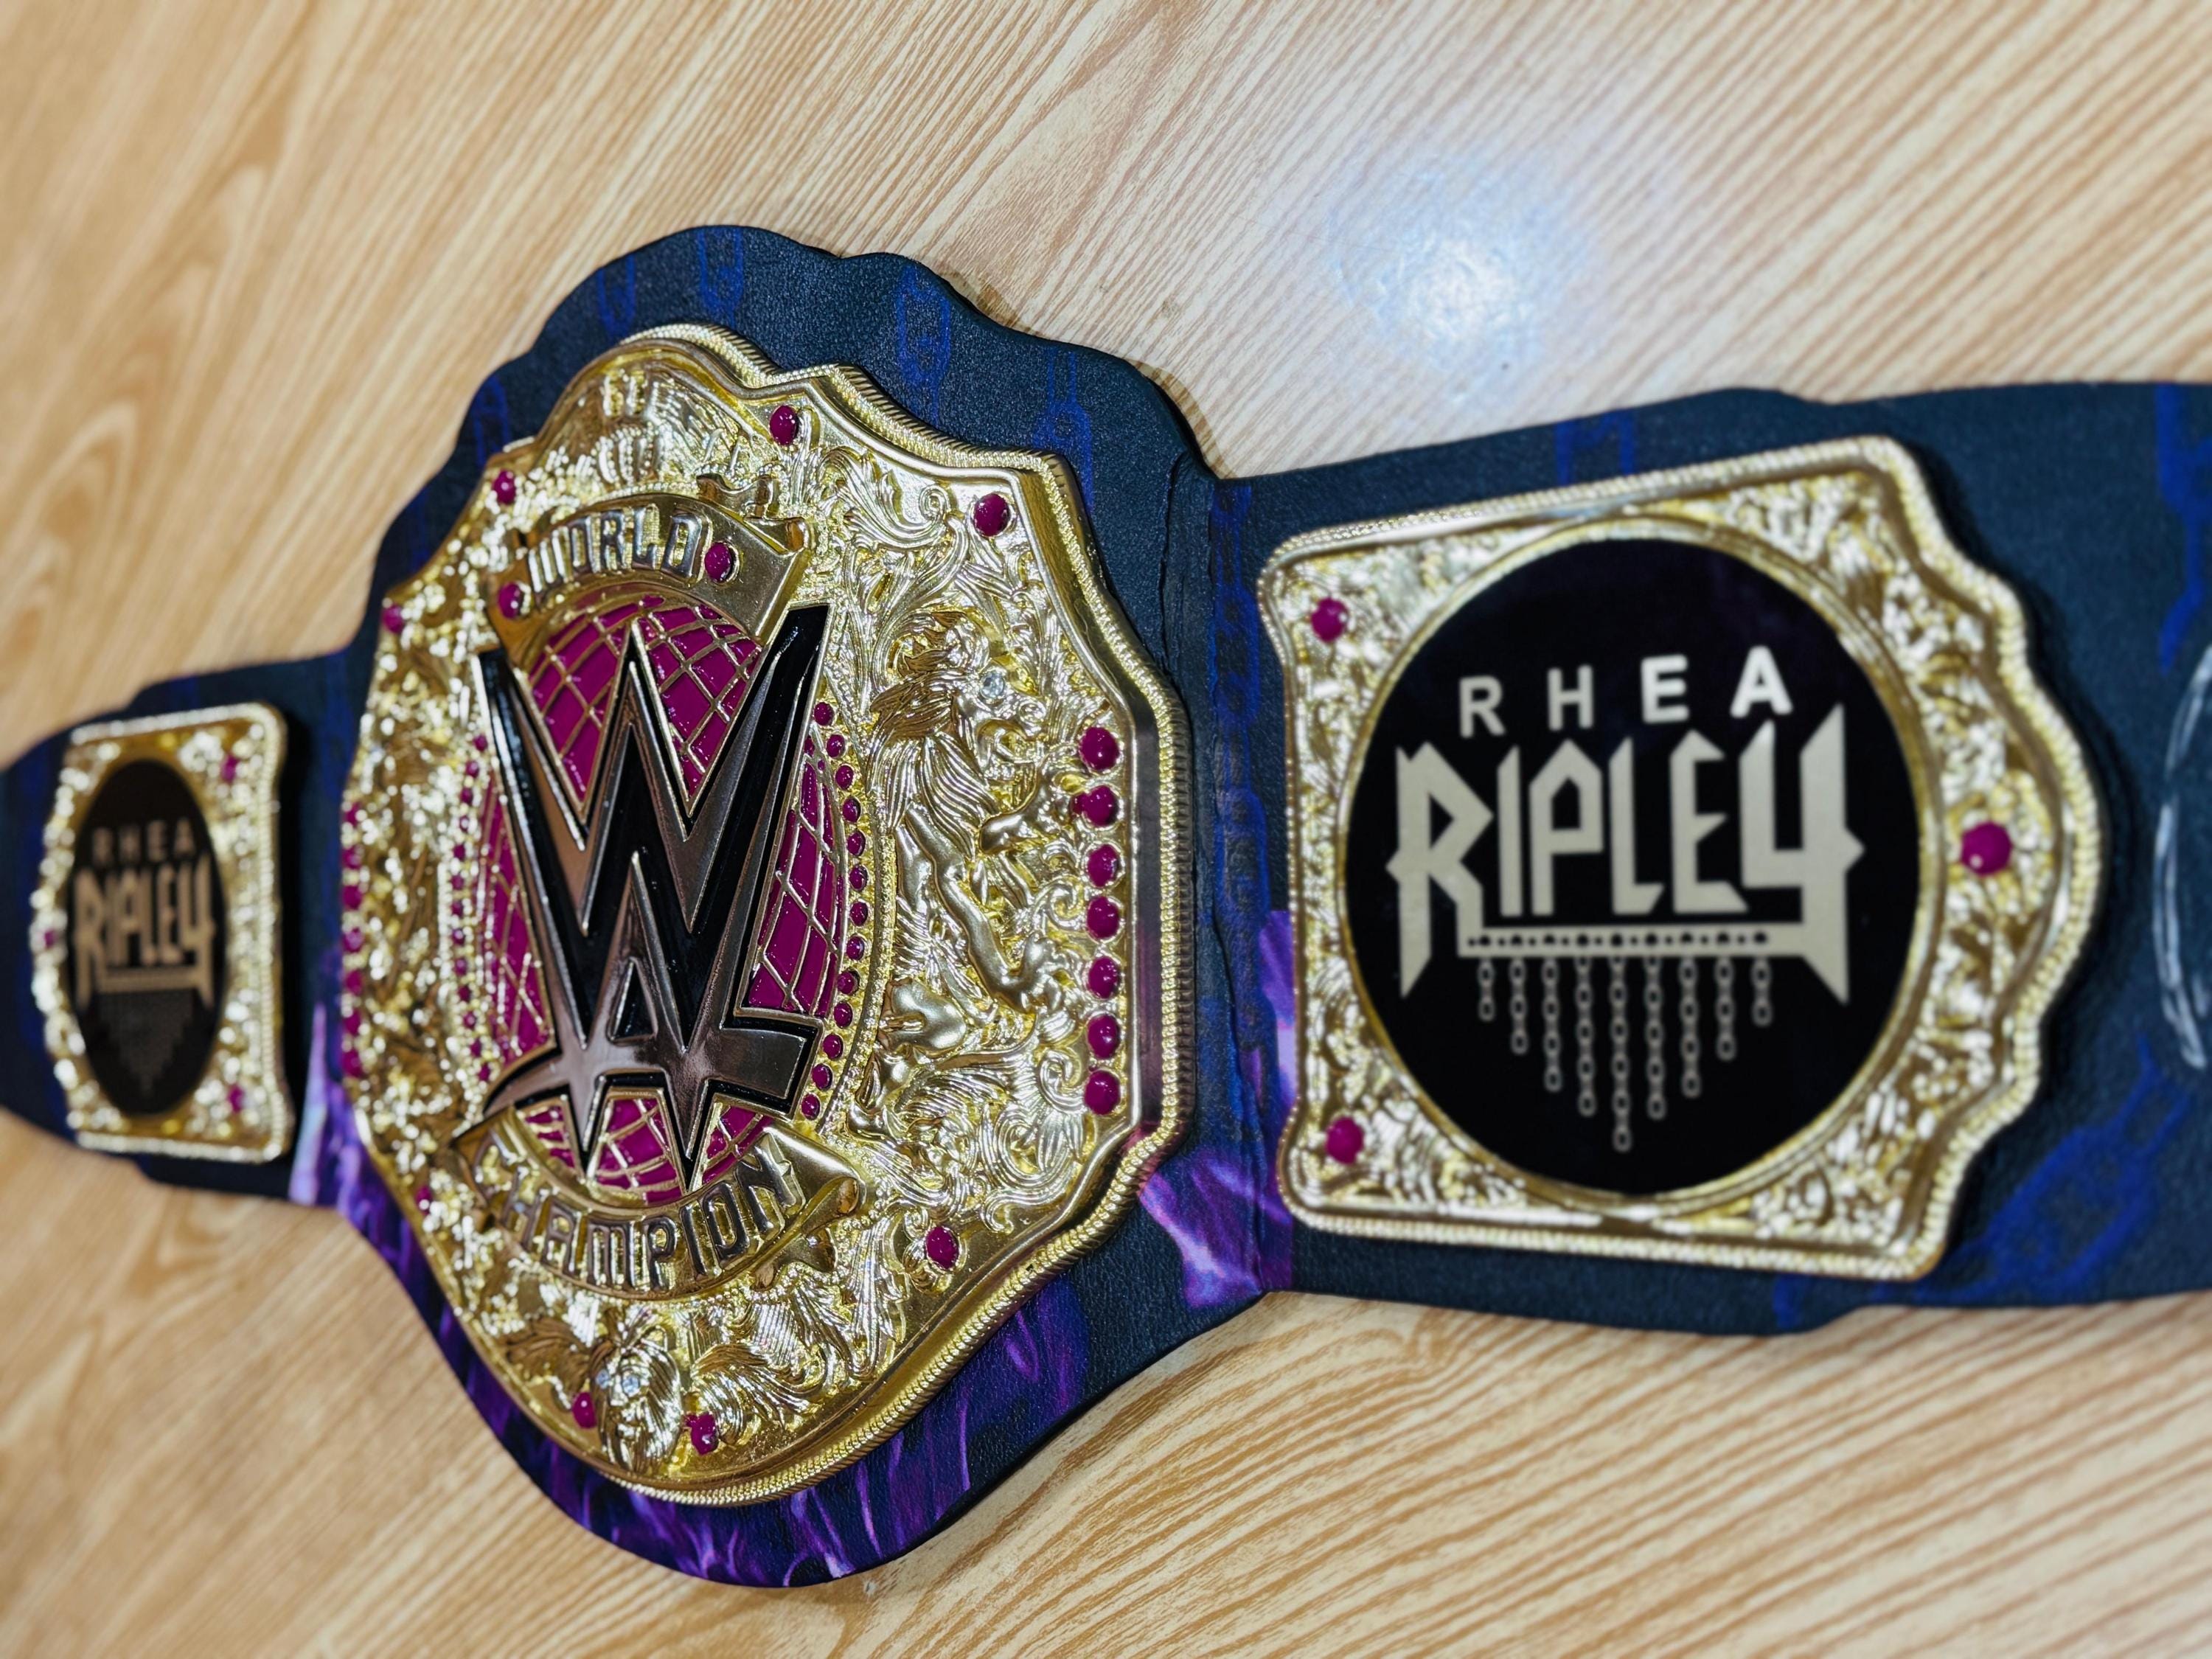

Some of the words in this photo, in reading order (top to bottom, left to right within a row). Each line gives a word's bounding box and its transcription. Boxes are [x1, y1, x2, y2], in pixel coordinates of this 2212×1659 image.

[526, 504, 700, 594] WORLD
[1458, 646, 1794, 737] RHEA
[1385, 703, 1865, 1006] RIPLEY
